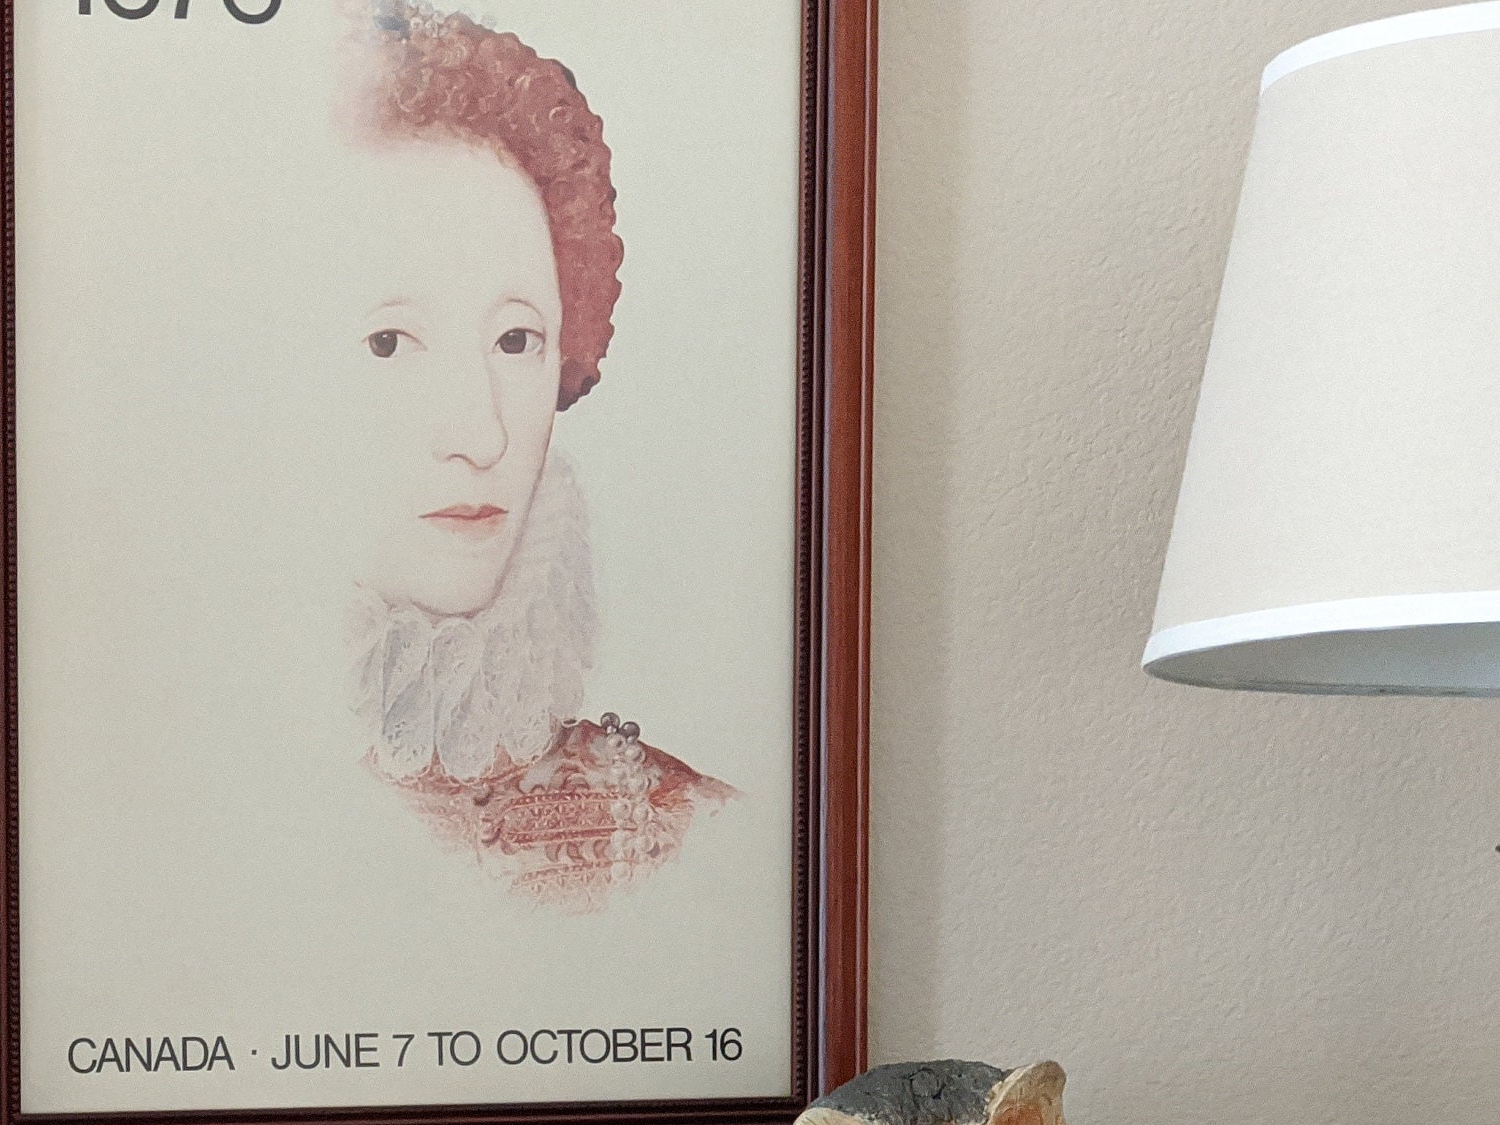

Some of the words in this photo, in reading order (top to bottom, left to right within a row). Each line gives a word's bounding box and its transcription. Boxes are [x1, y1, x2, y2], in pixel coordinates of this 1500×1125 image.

[67, 1036, 236, 1074] CANADA
[270, 1033, 381, 1070] JUNE
[392, 1032, 415, 1068] 7
[427, 1031, 482, 1068] TO
[496, 1027, 693, 1066] OCTOBER
[704, 1027, 743, 1062] 16
